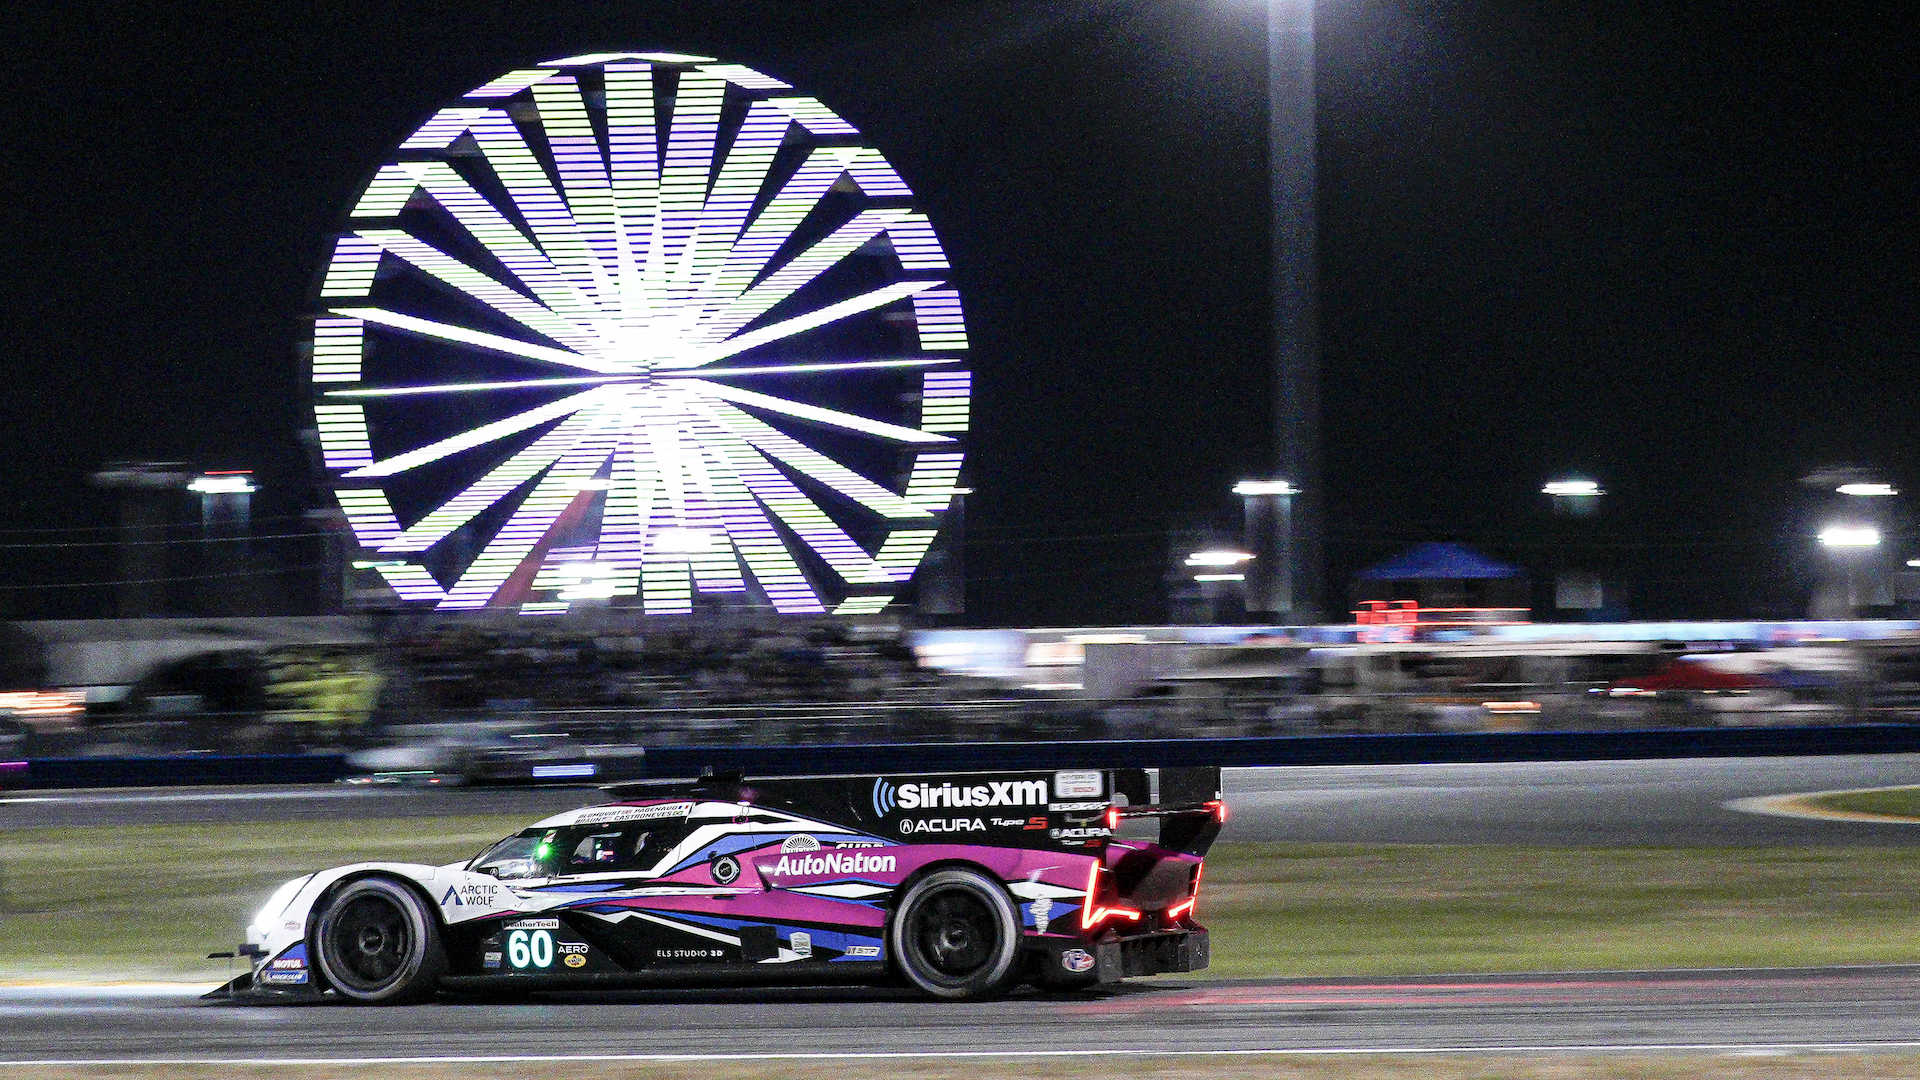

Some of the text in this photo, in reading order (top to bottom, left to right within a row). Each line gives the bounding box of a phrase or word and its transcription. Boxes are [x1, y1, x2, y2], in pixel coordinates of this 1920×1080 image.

[633, 804, 676, 813] PAGENAUD
[614, 811, 671, 820] CASTRONEVES
[914, 817, 1048, 833] ACURA Type S
[774, 853, 896, 876] AutoNation
[460, 885, 498, 895] ARCTIC
[466, 896, 494, 905] WOLF
[508, 929, 553, 968] 60
[558, 945, 589, 954] AERO
[656, 950, 672, 958] ELS
[674, 950, 708, 958] STUDIO
